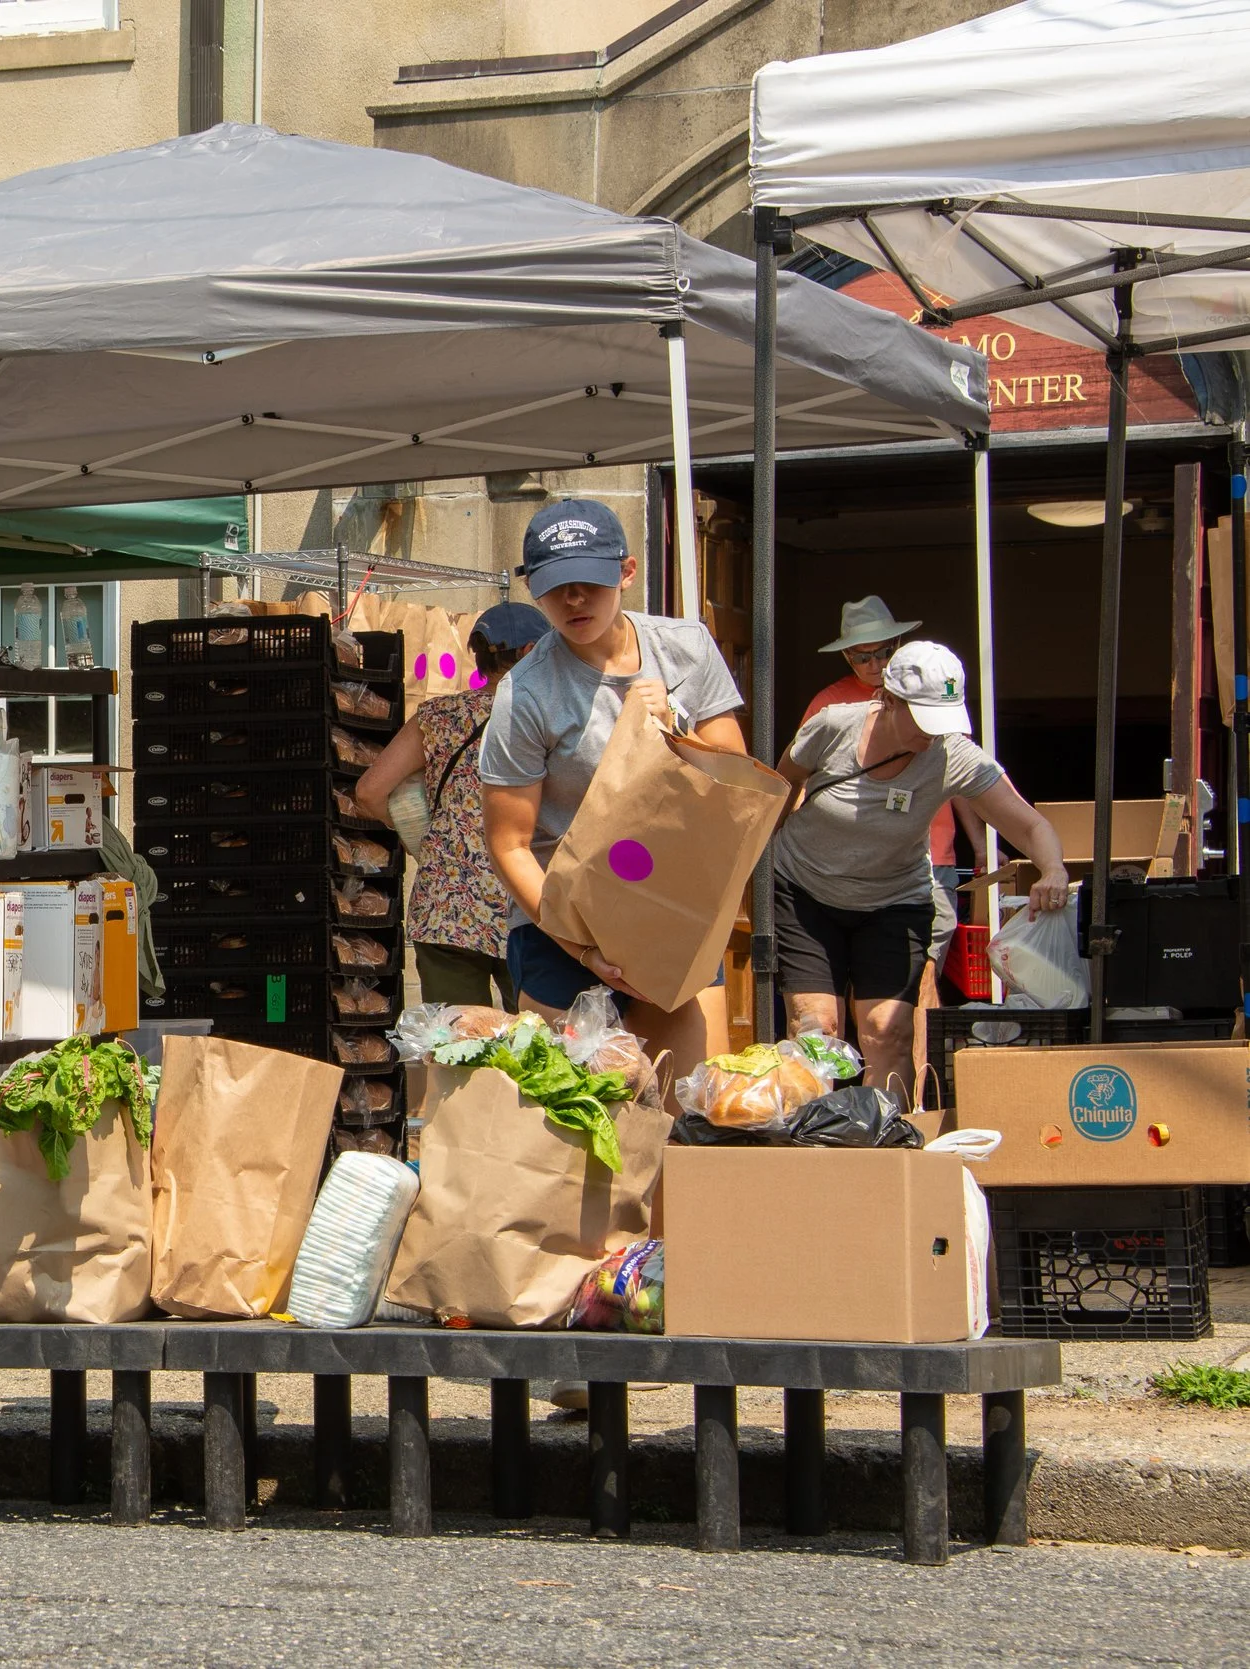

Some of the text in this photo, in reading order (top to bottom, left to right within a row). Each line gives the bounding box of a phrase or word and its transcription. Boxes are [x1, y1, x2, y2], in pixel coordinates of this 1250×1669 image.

[944, 332, 1016, 361] MO
[538, 519, 598, 542] GEORGE WASHINGTON
[549, 540, 588, 551] UNIVERSITY
[50, 771, 74, 782] diapers
[94, 782, 99, 791] 7
[1073, 1105, 1134, 1128] Chiquita
